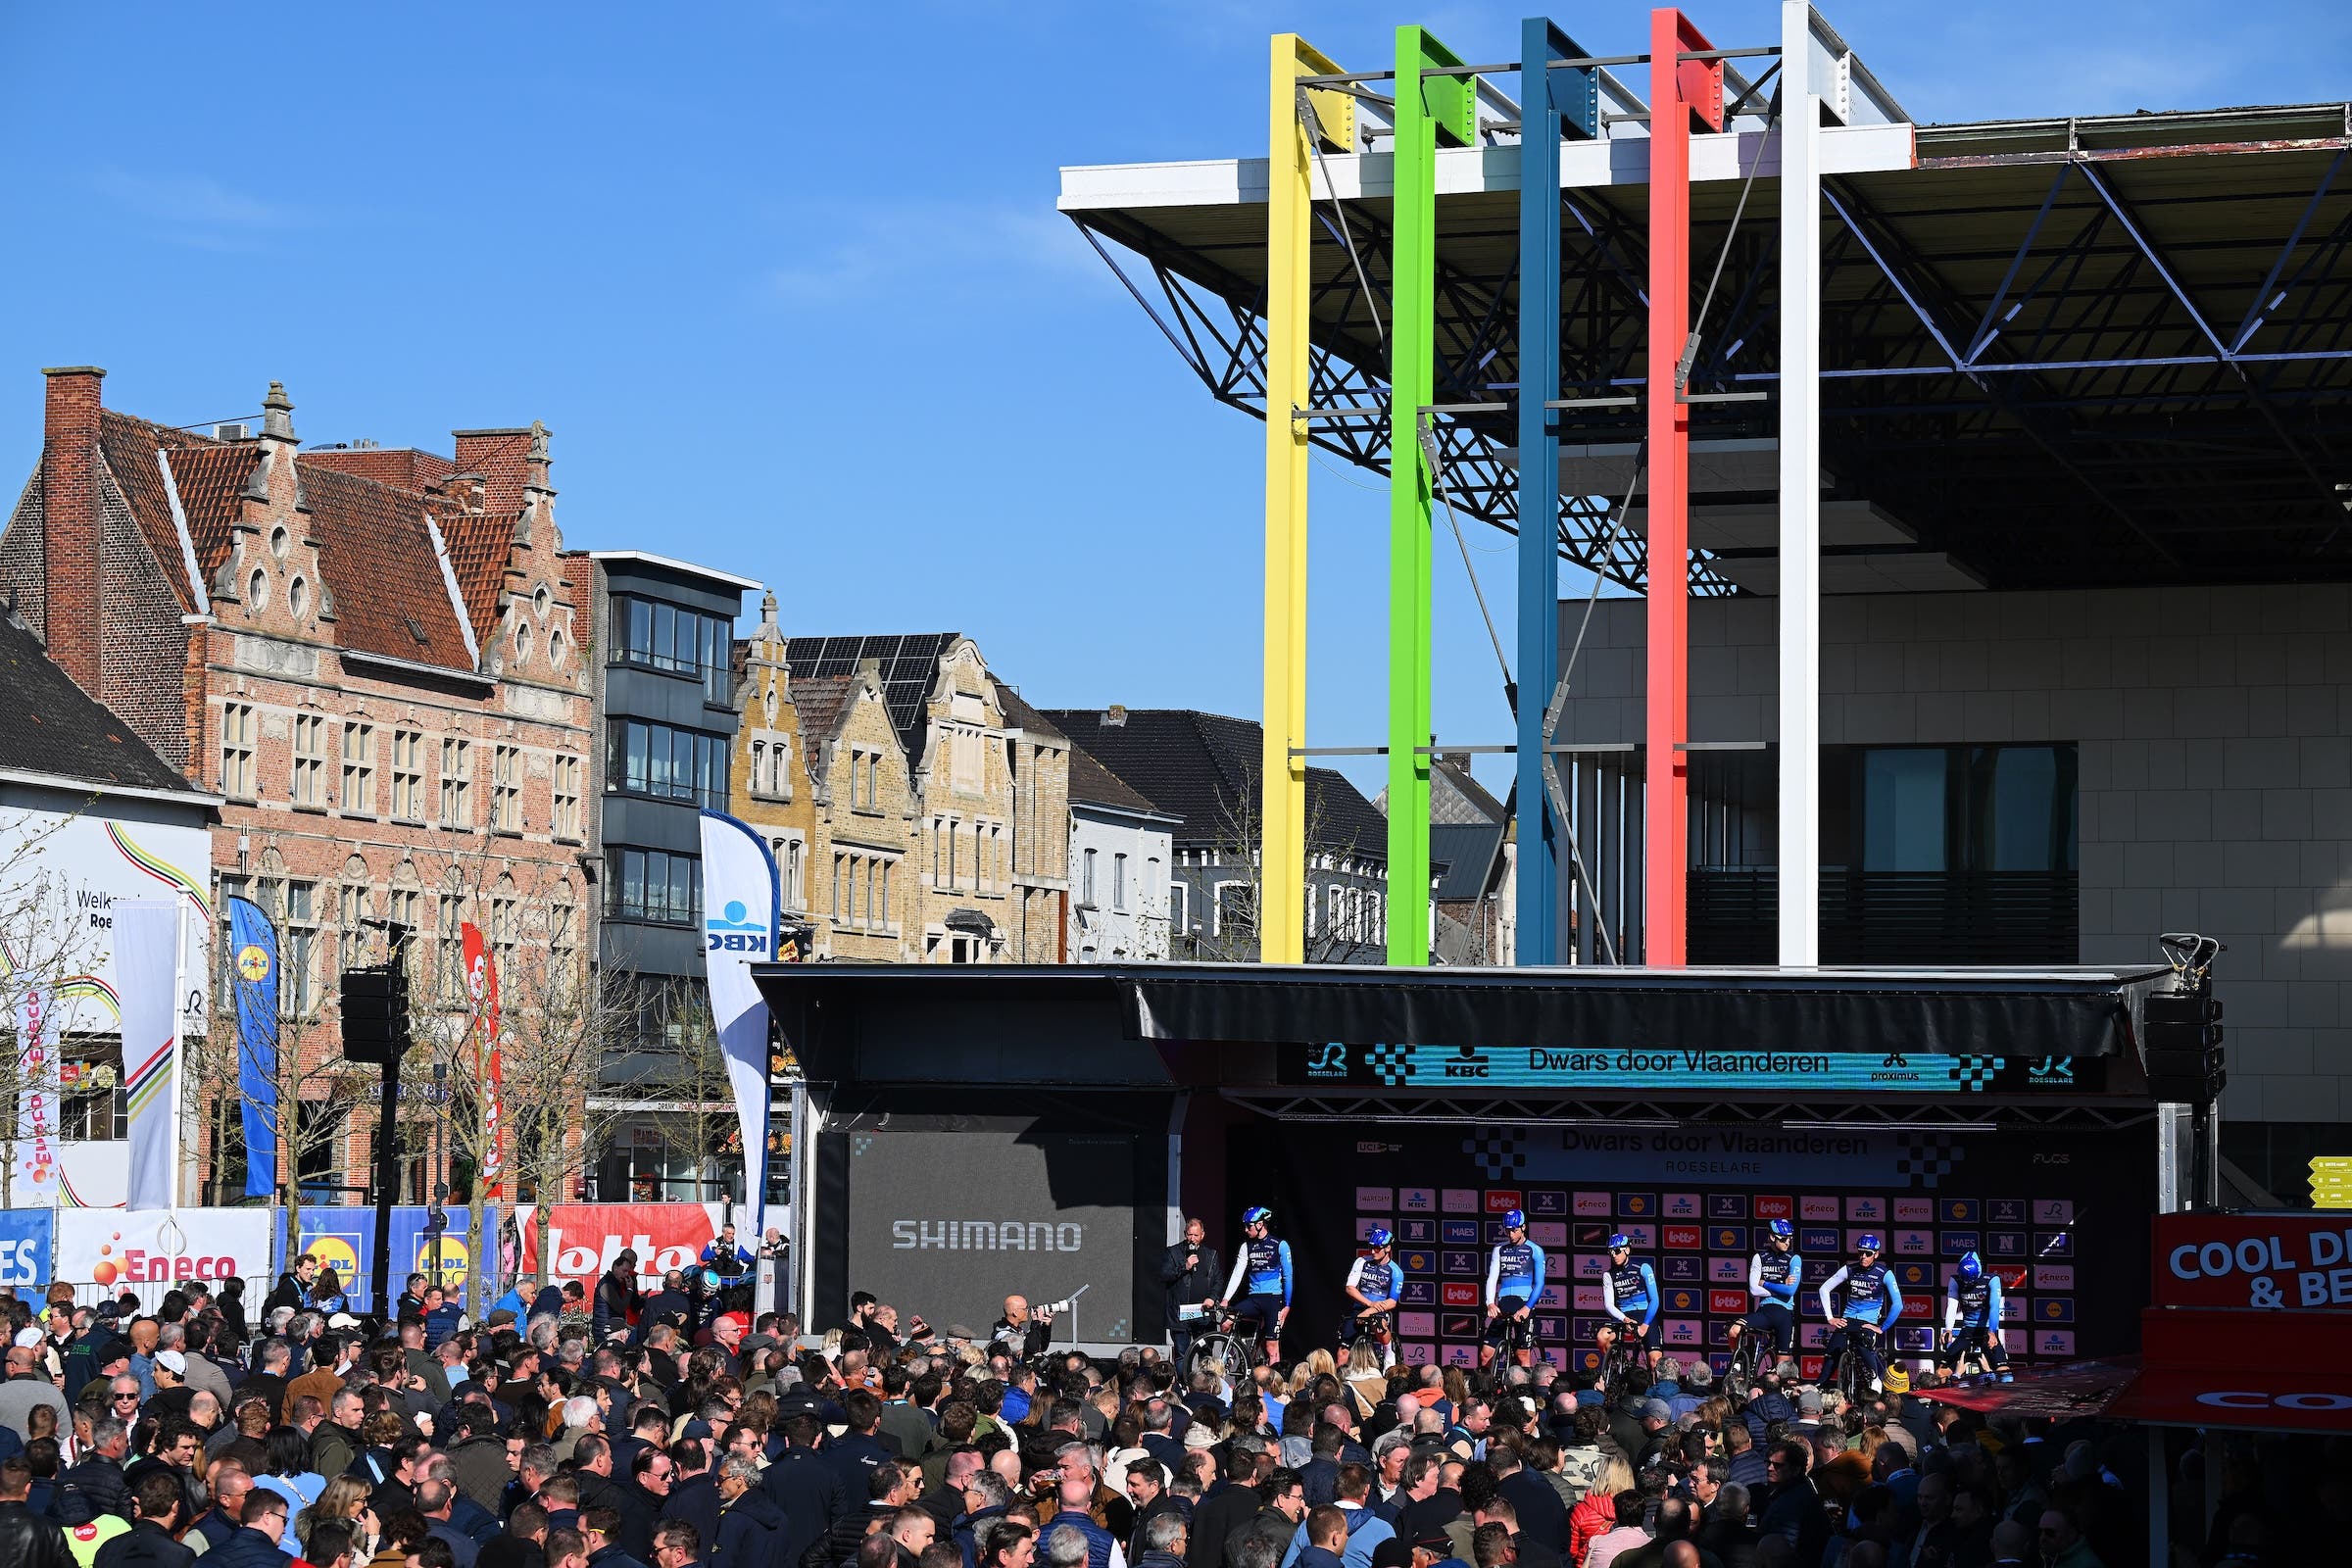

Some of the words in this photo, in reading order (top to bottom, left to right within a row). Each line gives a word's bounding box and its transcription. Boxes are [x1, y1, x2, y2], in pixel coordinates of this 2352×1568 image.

[1529, 1048, 1608, 1071] Dwars
[1617, 1050, 1677, 1072] door
[1683, 1052, 1829, 1073] Vlaanderen
[1446, 1065, 1489, 1078] KBC
[1871, 1070, 1919, 1082] proximus
[1563, 1129, 1643, 1152] Dwars
[1652, 1132, 1710, 1153] door
[1720, 1133, 1868, 1154] Vlaanderen
[1666, 1161, 1761, 1174] ROESELARE
[1855, 1209, 1877, 1218] KBC
[893, 1220, 1082, 1252] SHIMANO
[1451, 1228, 1475, 1238] MAES
[1810, 1236, 1835, 1247] MAES
[1903, 1242, 1925, 1250] KBC
[1951, 1239, 1976, 1249] MAES
[2169, 1236, 2297, 1280] COOL
[125, 1250, 236, 1282] Eneco
[2249, 1276, 2287, 1310] &
[2044, 1344, 2066, 1352] KBC
